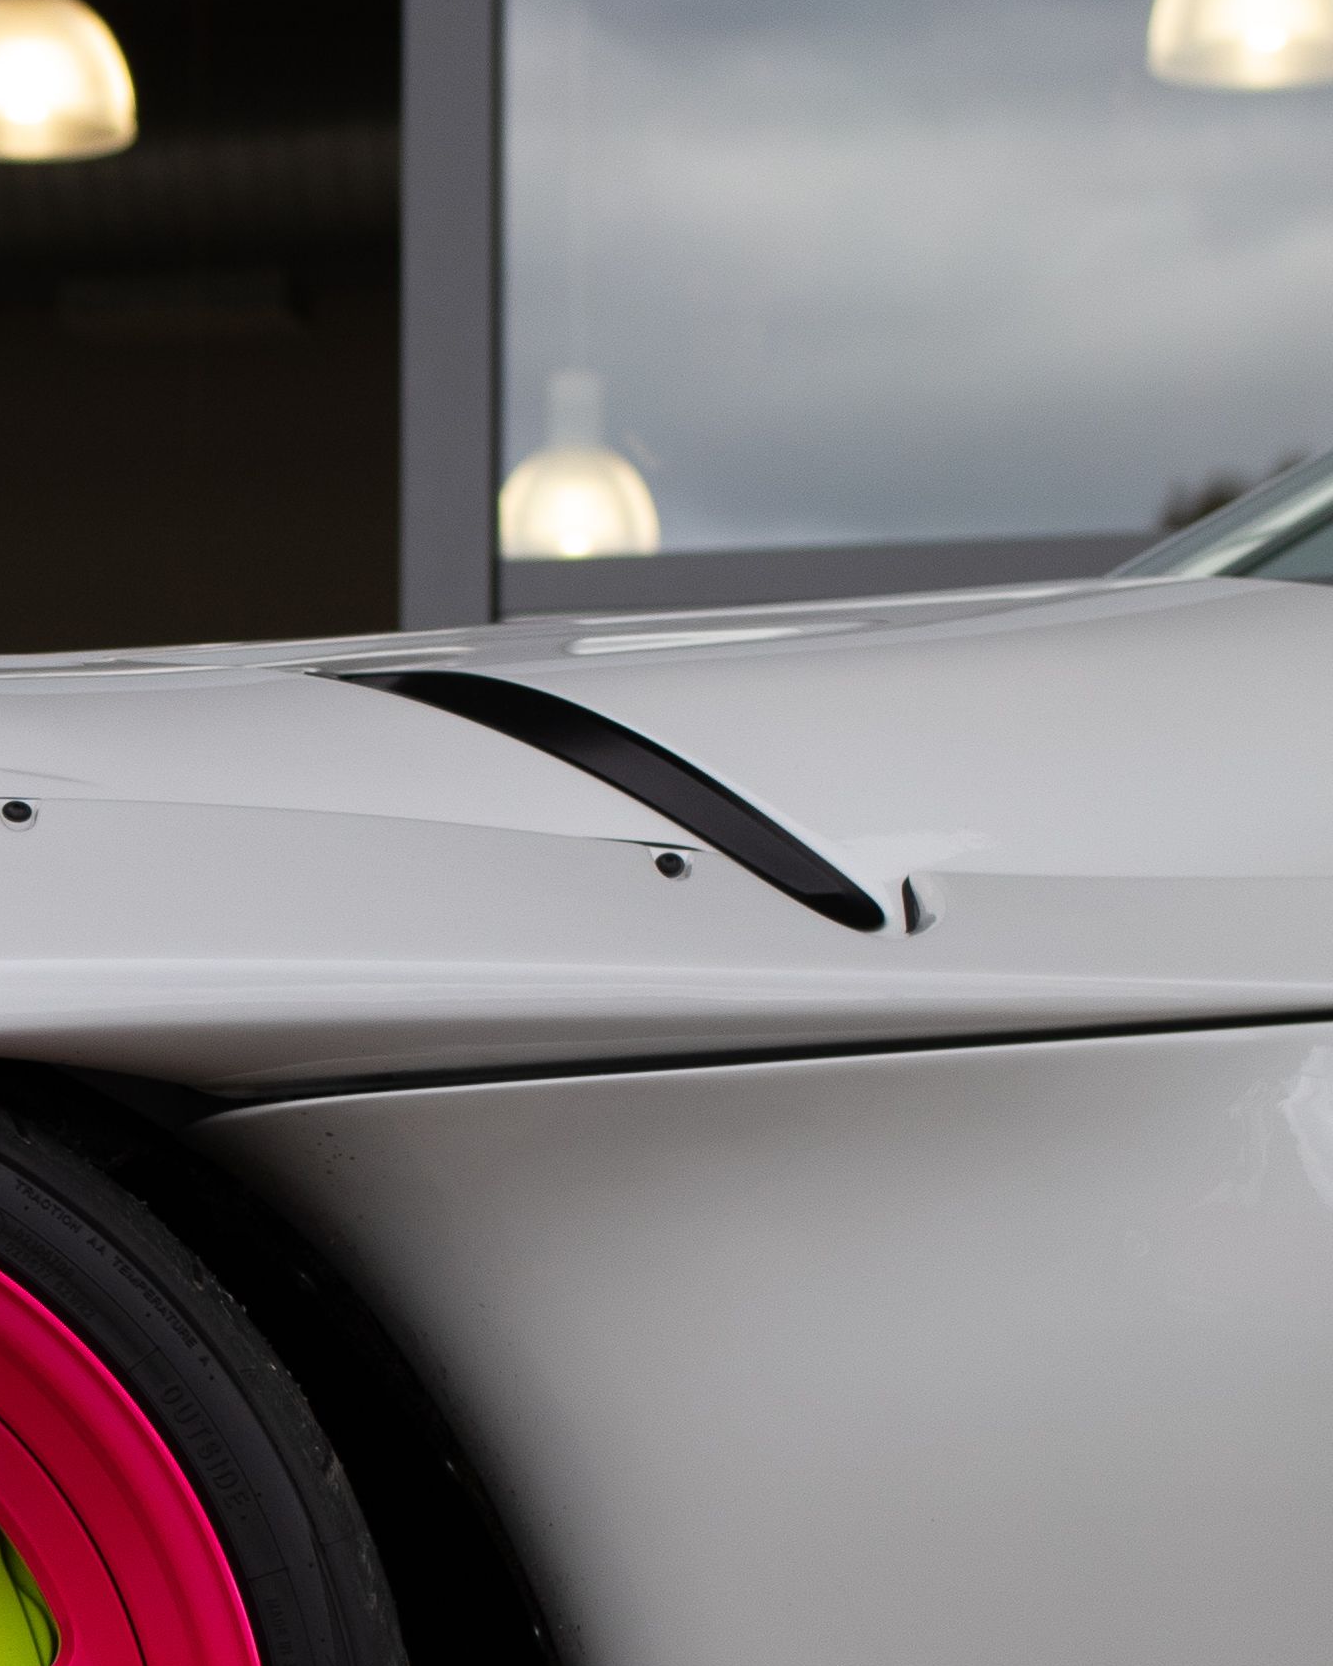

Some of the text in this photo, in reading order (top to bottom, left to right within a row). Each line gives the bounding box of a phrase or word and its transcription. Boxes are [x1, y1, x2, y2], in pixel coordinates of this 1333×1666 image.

[10, 1177, 83, 1234] TRACTION
[85, 1233, 110, 1256] AA
[108, 1253, 199, 1350] TEMPERATURE
[154, 1378, 251, 1512] OUTSIDE
